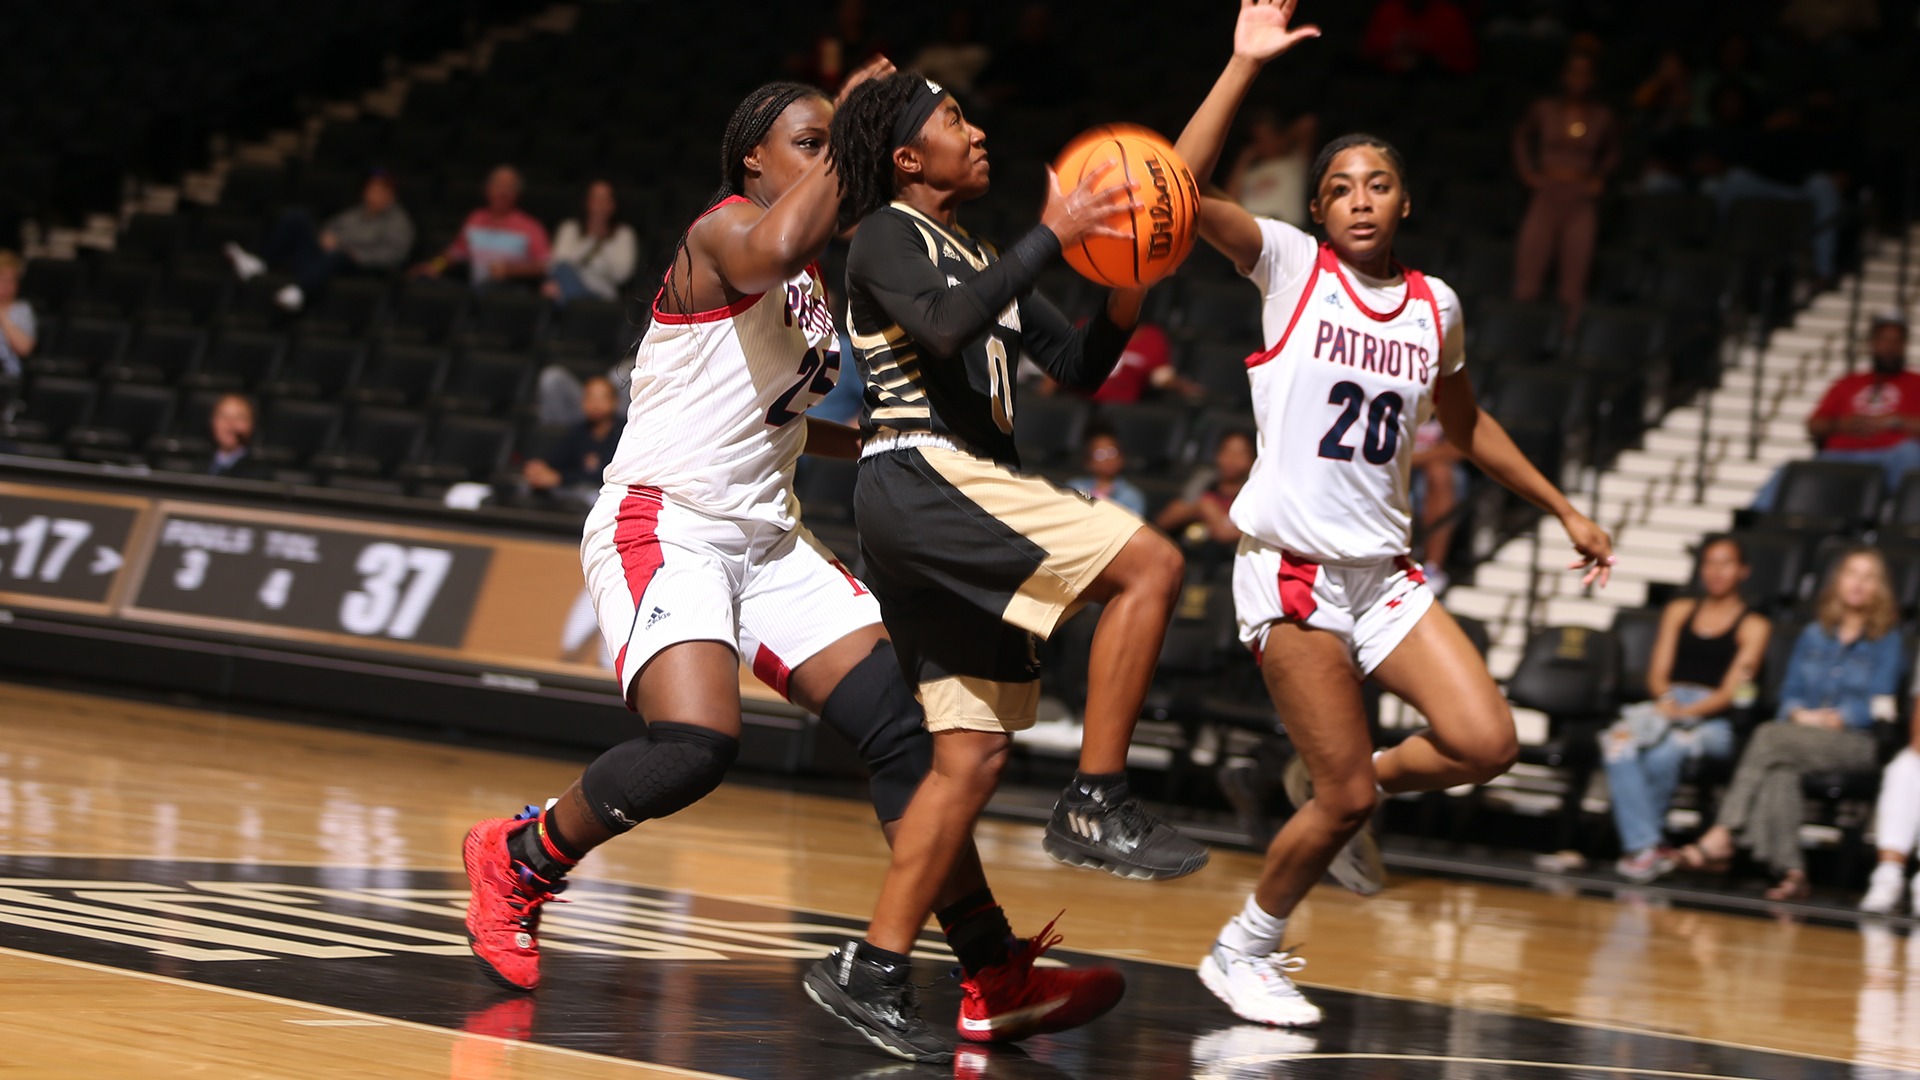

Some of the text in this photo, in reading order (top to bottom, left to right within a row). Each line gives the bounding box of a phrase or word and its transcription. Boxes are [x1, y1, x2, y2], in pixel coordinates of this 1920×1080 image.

[1145, 159, 1174, 264] Wilson
[764, 346, 841, 428] 25
[985, 335, 1014, 435] 0
[1313, 319, 1430, 386] PATRIOTS
[1317, 379, 1404, 466] 20
[173, 549, 210, 591] 3
[257, 567, 294, 611] 4
[339, 541, 454, 640] 37
